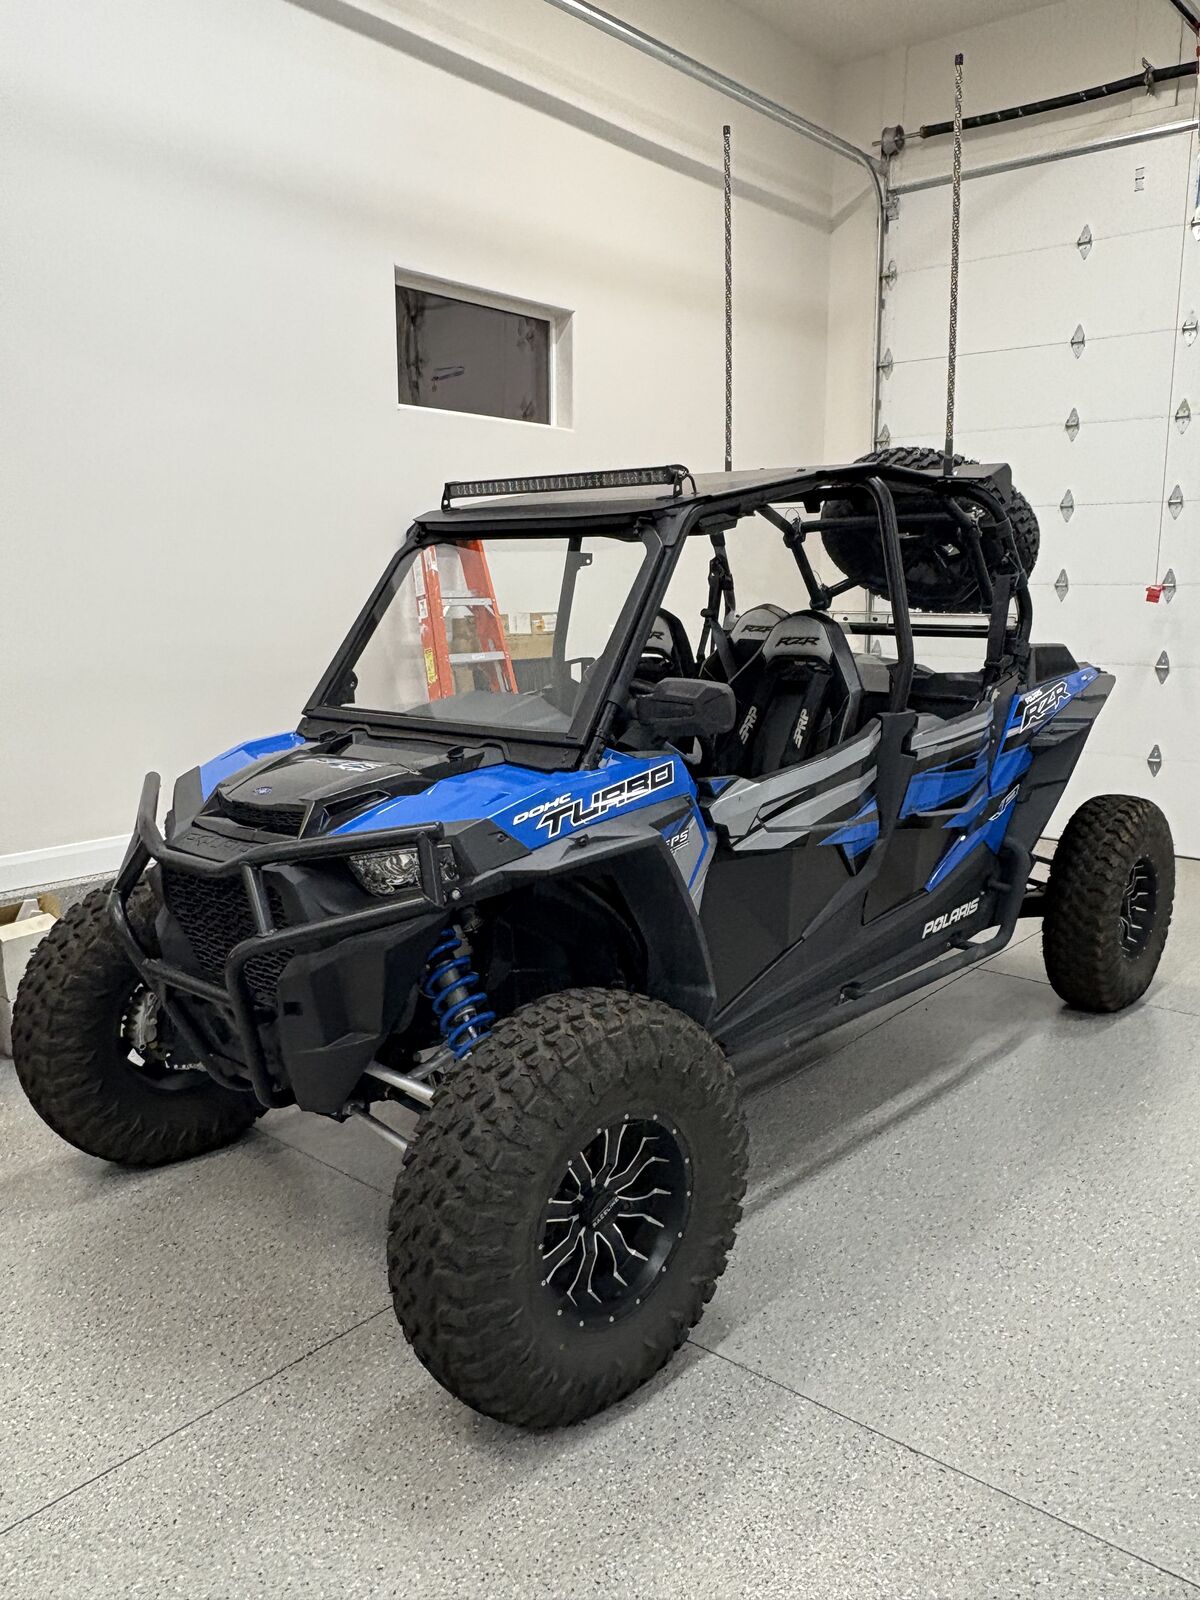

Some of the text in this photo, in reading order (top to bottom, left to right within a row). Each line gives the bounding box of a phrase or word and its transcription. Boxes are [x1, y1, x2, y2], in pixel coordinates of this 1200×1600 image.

[775, 636, 820, 648] RZR
[1020, 680, 1072, 734] RZR
[512, 792, 572, 826] DOHC
[535, 760, 675, 839] TURBO
[921, 897, 980, 940] POLARIS
